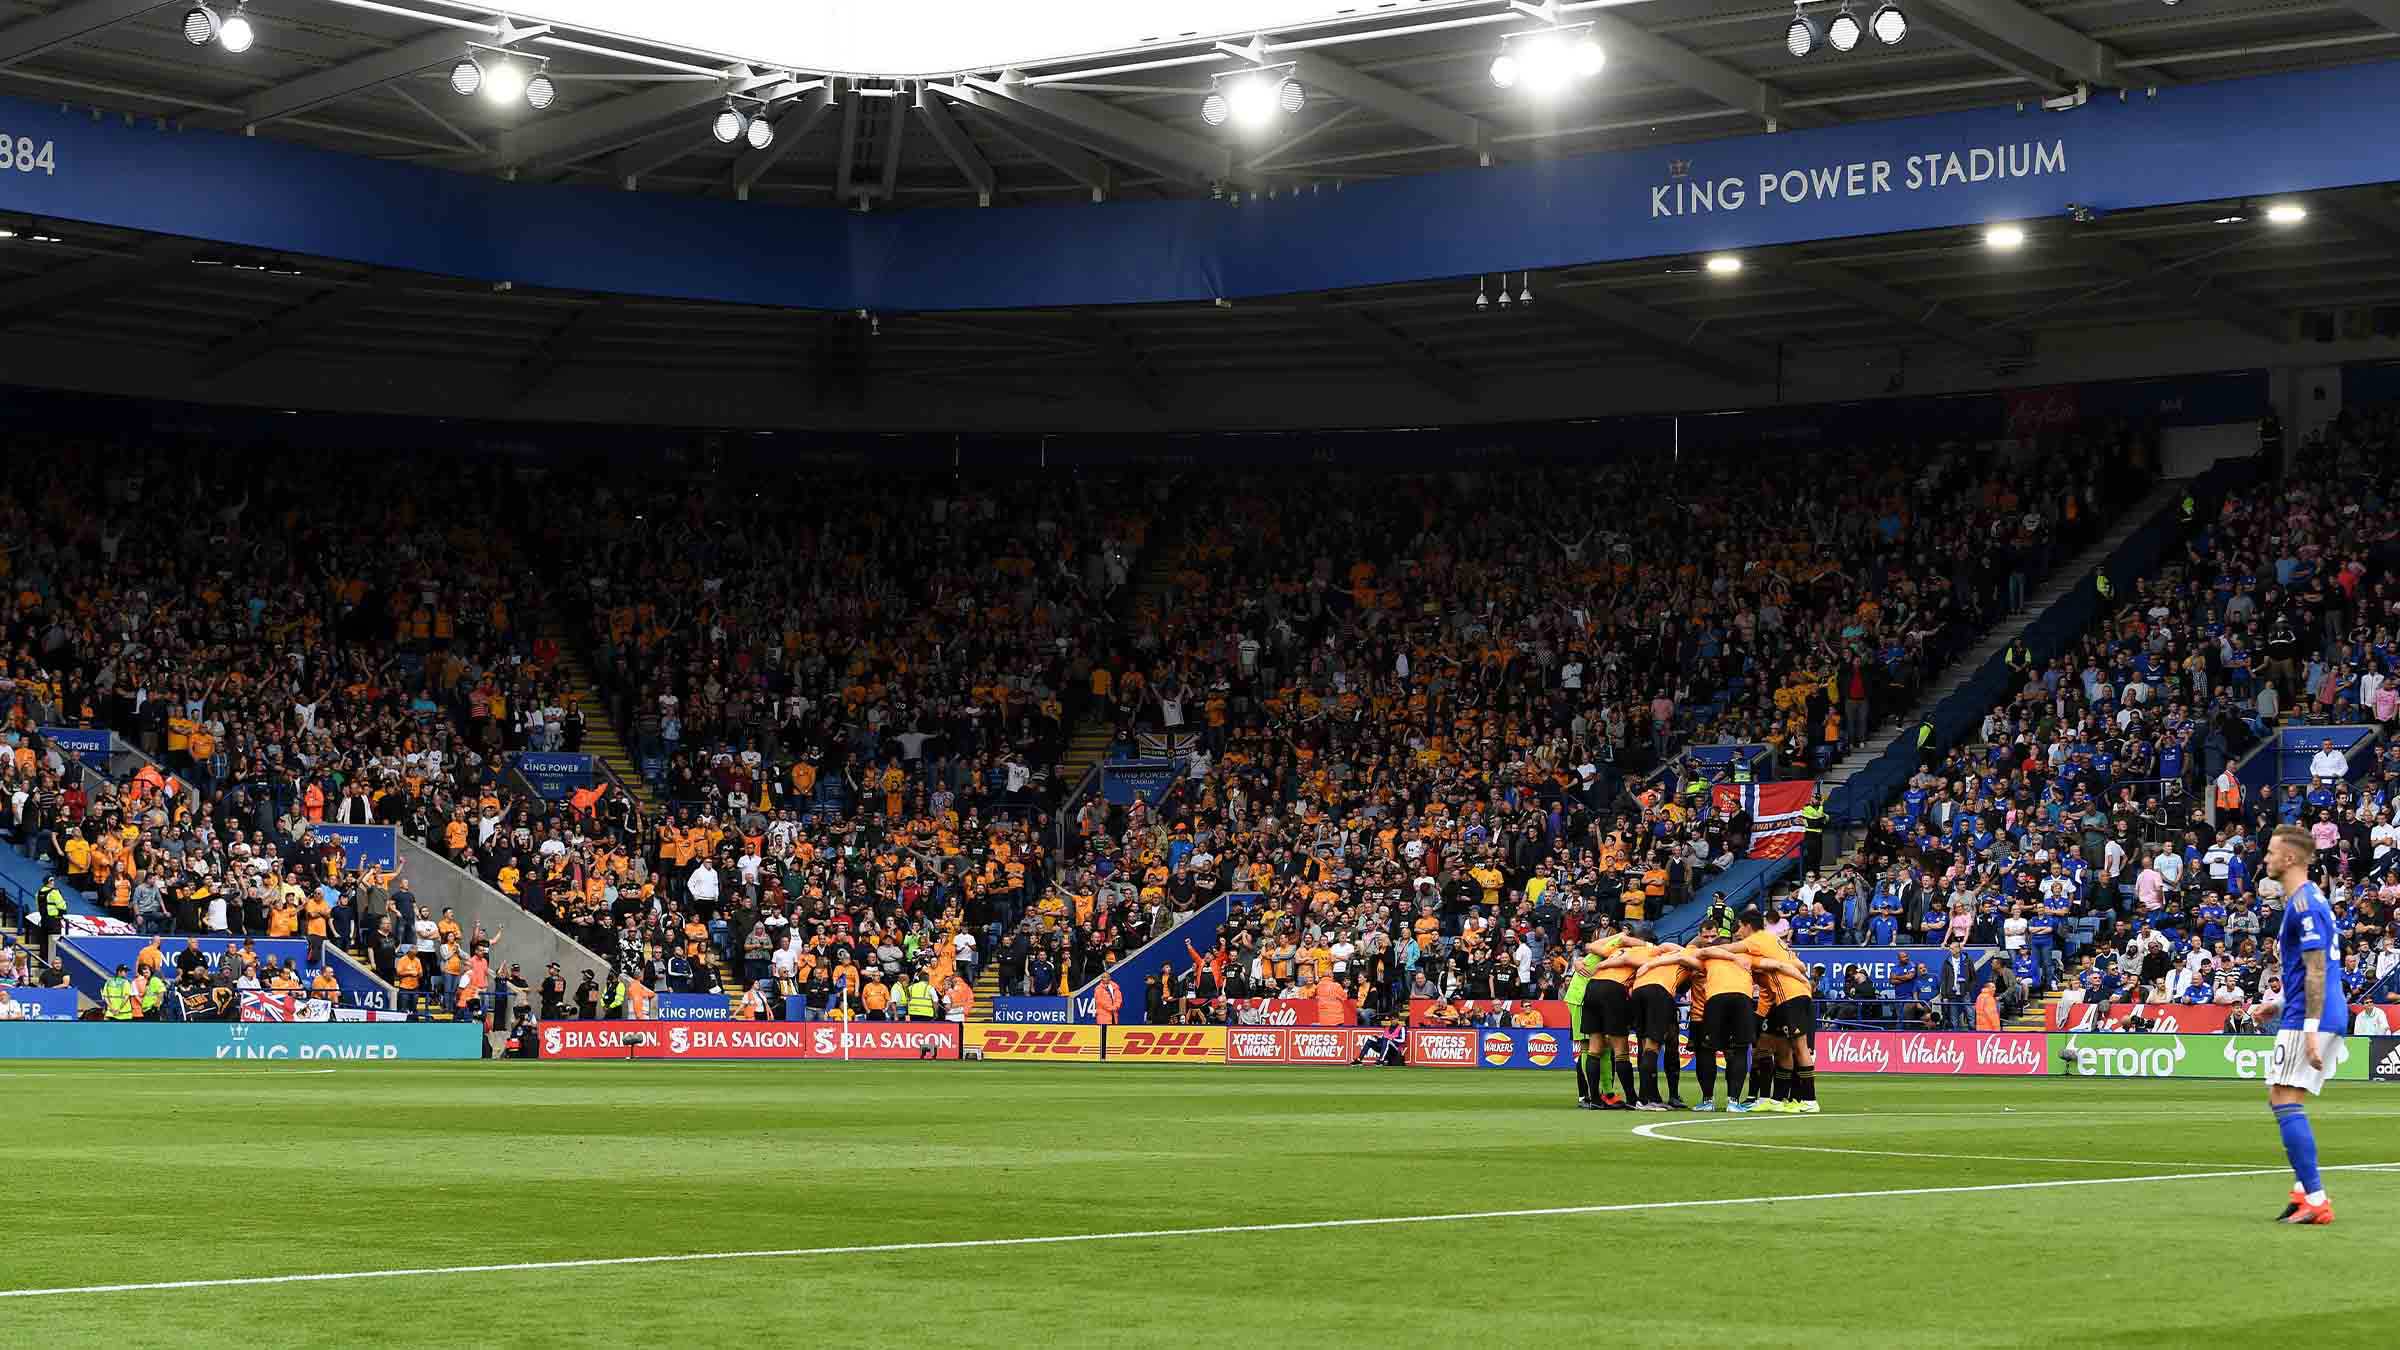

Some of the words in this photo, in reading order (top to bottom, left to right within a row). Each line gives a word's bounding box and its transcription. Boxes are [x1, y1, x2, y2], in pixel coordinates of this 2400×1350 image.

[1651, 177, 1745, 218] KING
[1759, 160, 1892, 206] POWER
[1905, 139, 2066, 190] STADIUM
[71, 741, 100, 751] POWER
[523, 763, 546, 772] KING
[548, 763, 579, 773] POWER
[305, 968, 321, 978] V45
[352, 991, 384, 1009] V45
[659, 1007, 687, 1019] KING
[689, 1007, 727, 1019] POWER
[995, 1010, 1023, 1022] KING
[1026, 1011, 1066, 1022] POWER
[565, 1031, 596, 1048] BIA
[693, 1031, 728, 1048] BIA
[731, 1031, 800, 1048] SAIGON
[840, 1033, 876, 1048] BIA
[880, 1033, 952, 1050] SAIGON
[982, 1029, 1082, 1053] DHL
[1122, 1032, 1208, 1056] DHL
[1232, 1033, 1276, 1045] XPRESS
[1295, 1033, 1338, 1045] XPRESS
[1420, 1035, 1466, 1048] XPRESS
[1241, 1044, 1282, 1057] MONEY
[1303, 1045, 1344, 1058] MONEY
[1483, 1040, 1514, 1053] WALKERS
[1527, 1040, 1558, 1053] WALKERS
[1827, 1032, 1889, 1073] Vitality
[1430, 1047, 1473, 1060] MONEY
[1900, 1033, 1966, 1074] Vitality
[1975, 1033, 2041, 1074] Vitality
